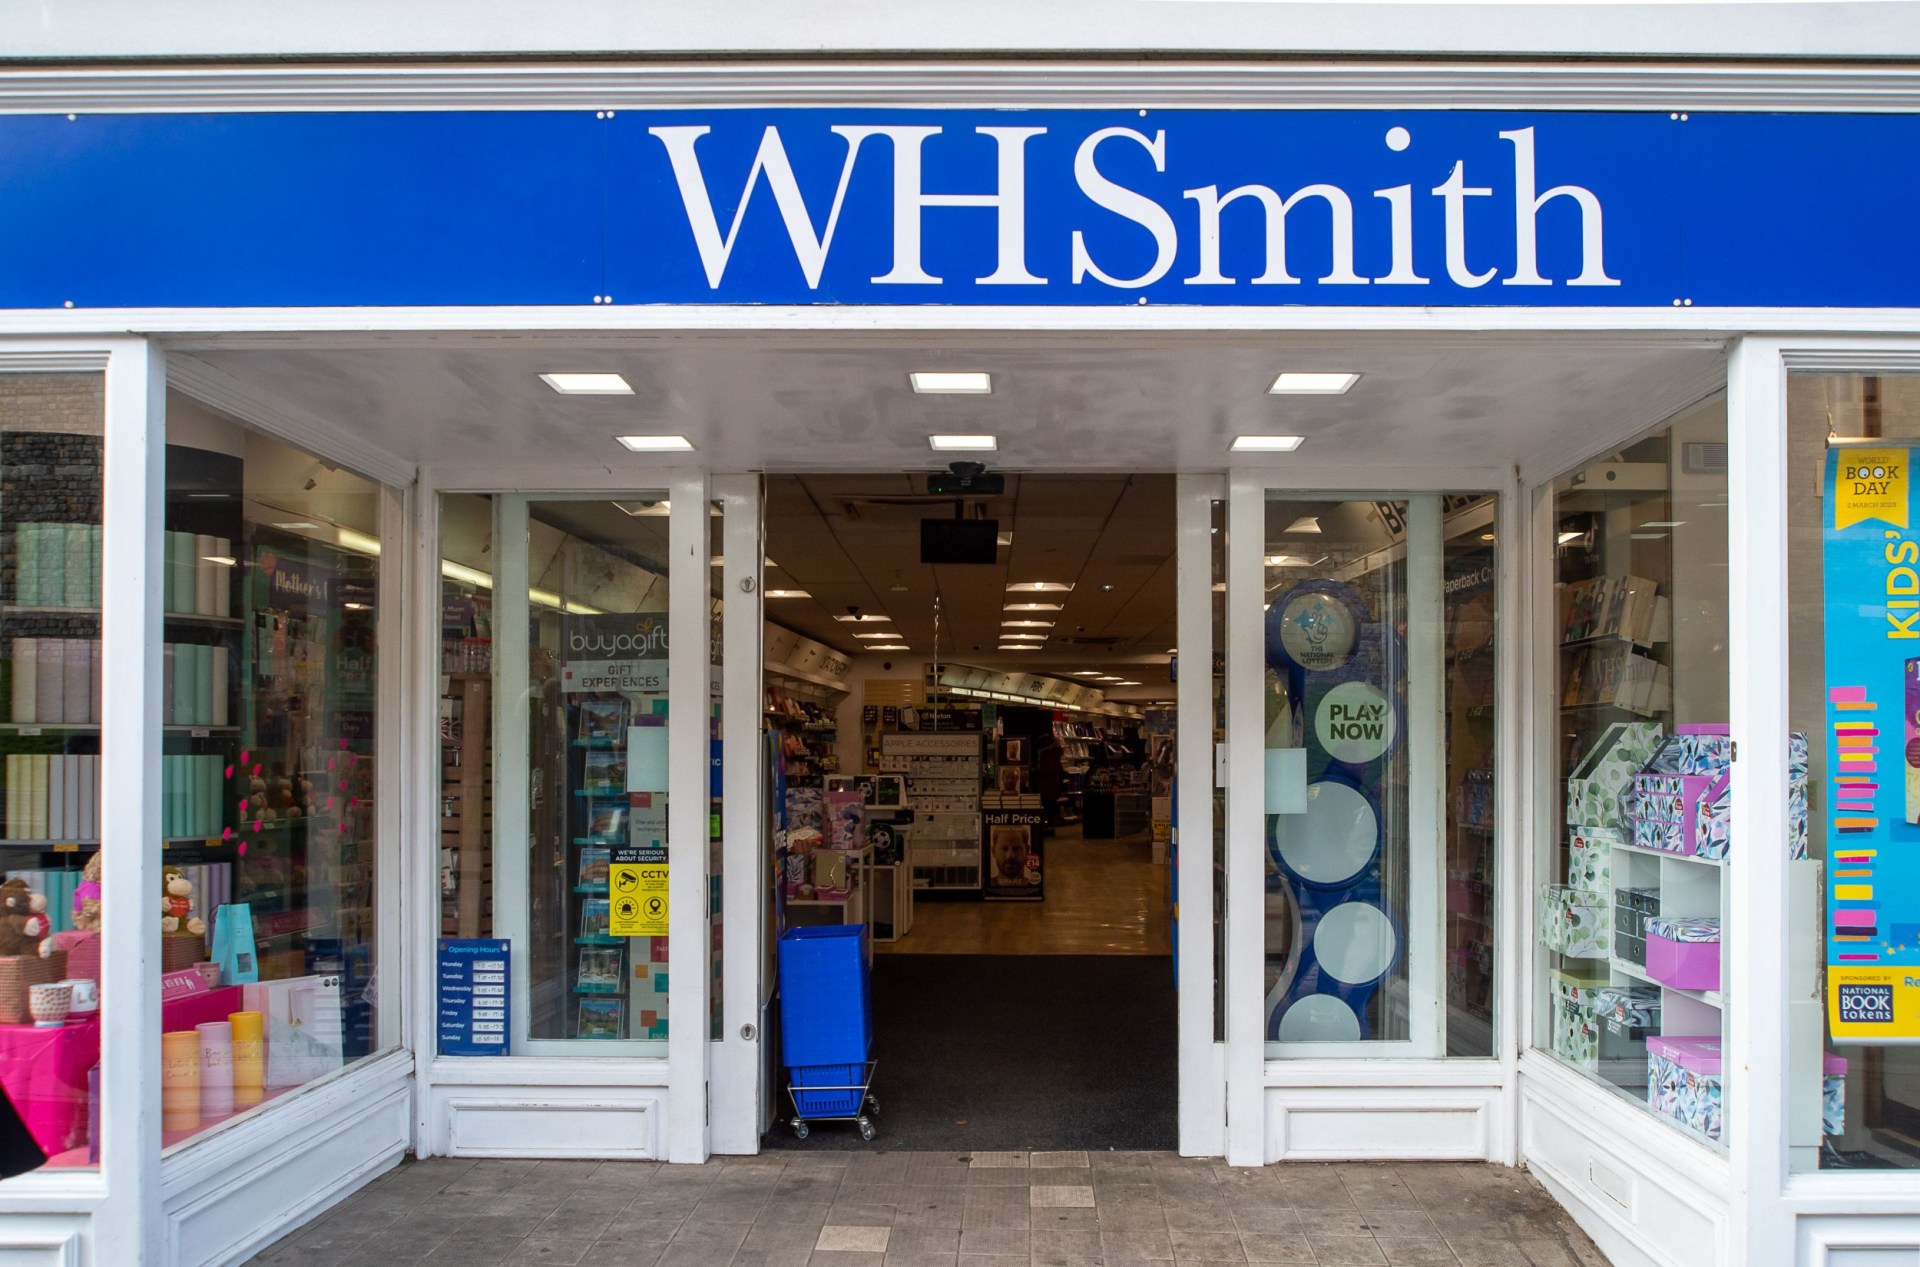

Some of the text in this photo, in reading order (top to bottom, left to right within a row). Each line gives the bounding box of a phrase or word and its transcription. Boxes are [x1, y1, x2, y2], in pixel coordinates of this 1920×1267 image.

[647, 125, 1622, 290] WHSmith
[1845, 466, 1899, 480] BOOK
[1854, 481, 1890, 495] DAY
[276, 570, 322, 600] Mother's
[1884, 530, 1920, 639] KIDS'
[570, 625, 669, 657] buyagift
[336, 656, 371, 670] Half
[608, 665, 632, 675] GIFT
[338, 671, 367, 680] Price
[929, 712, 952, 720] Nrton
[1330, 704, 1384, 721] PLAY
[1330, 723, 1384, 740] NOW
[884, 740, 978, 748] APPLE ACCESSORIES
[985, 814, 1041, 824] Half Price
[641, 870, 669, 879] CCTV
[448, 946, 478, 954] Opening
[1842, 995, 1890, 1010] BOOK
[1843, 1009, 1891, 1020] tokens
